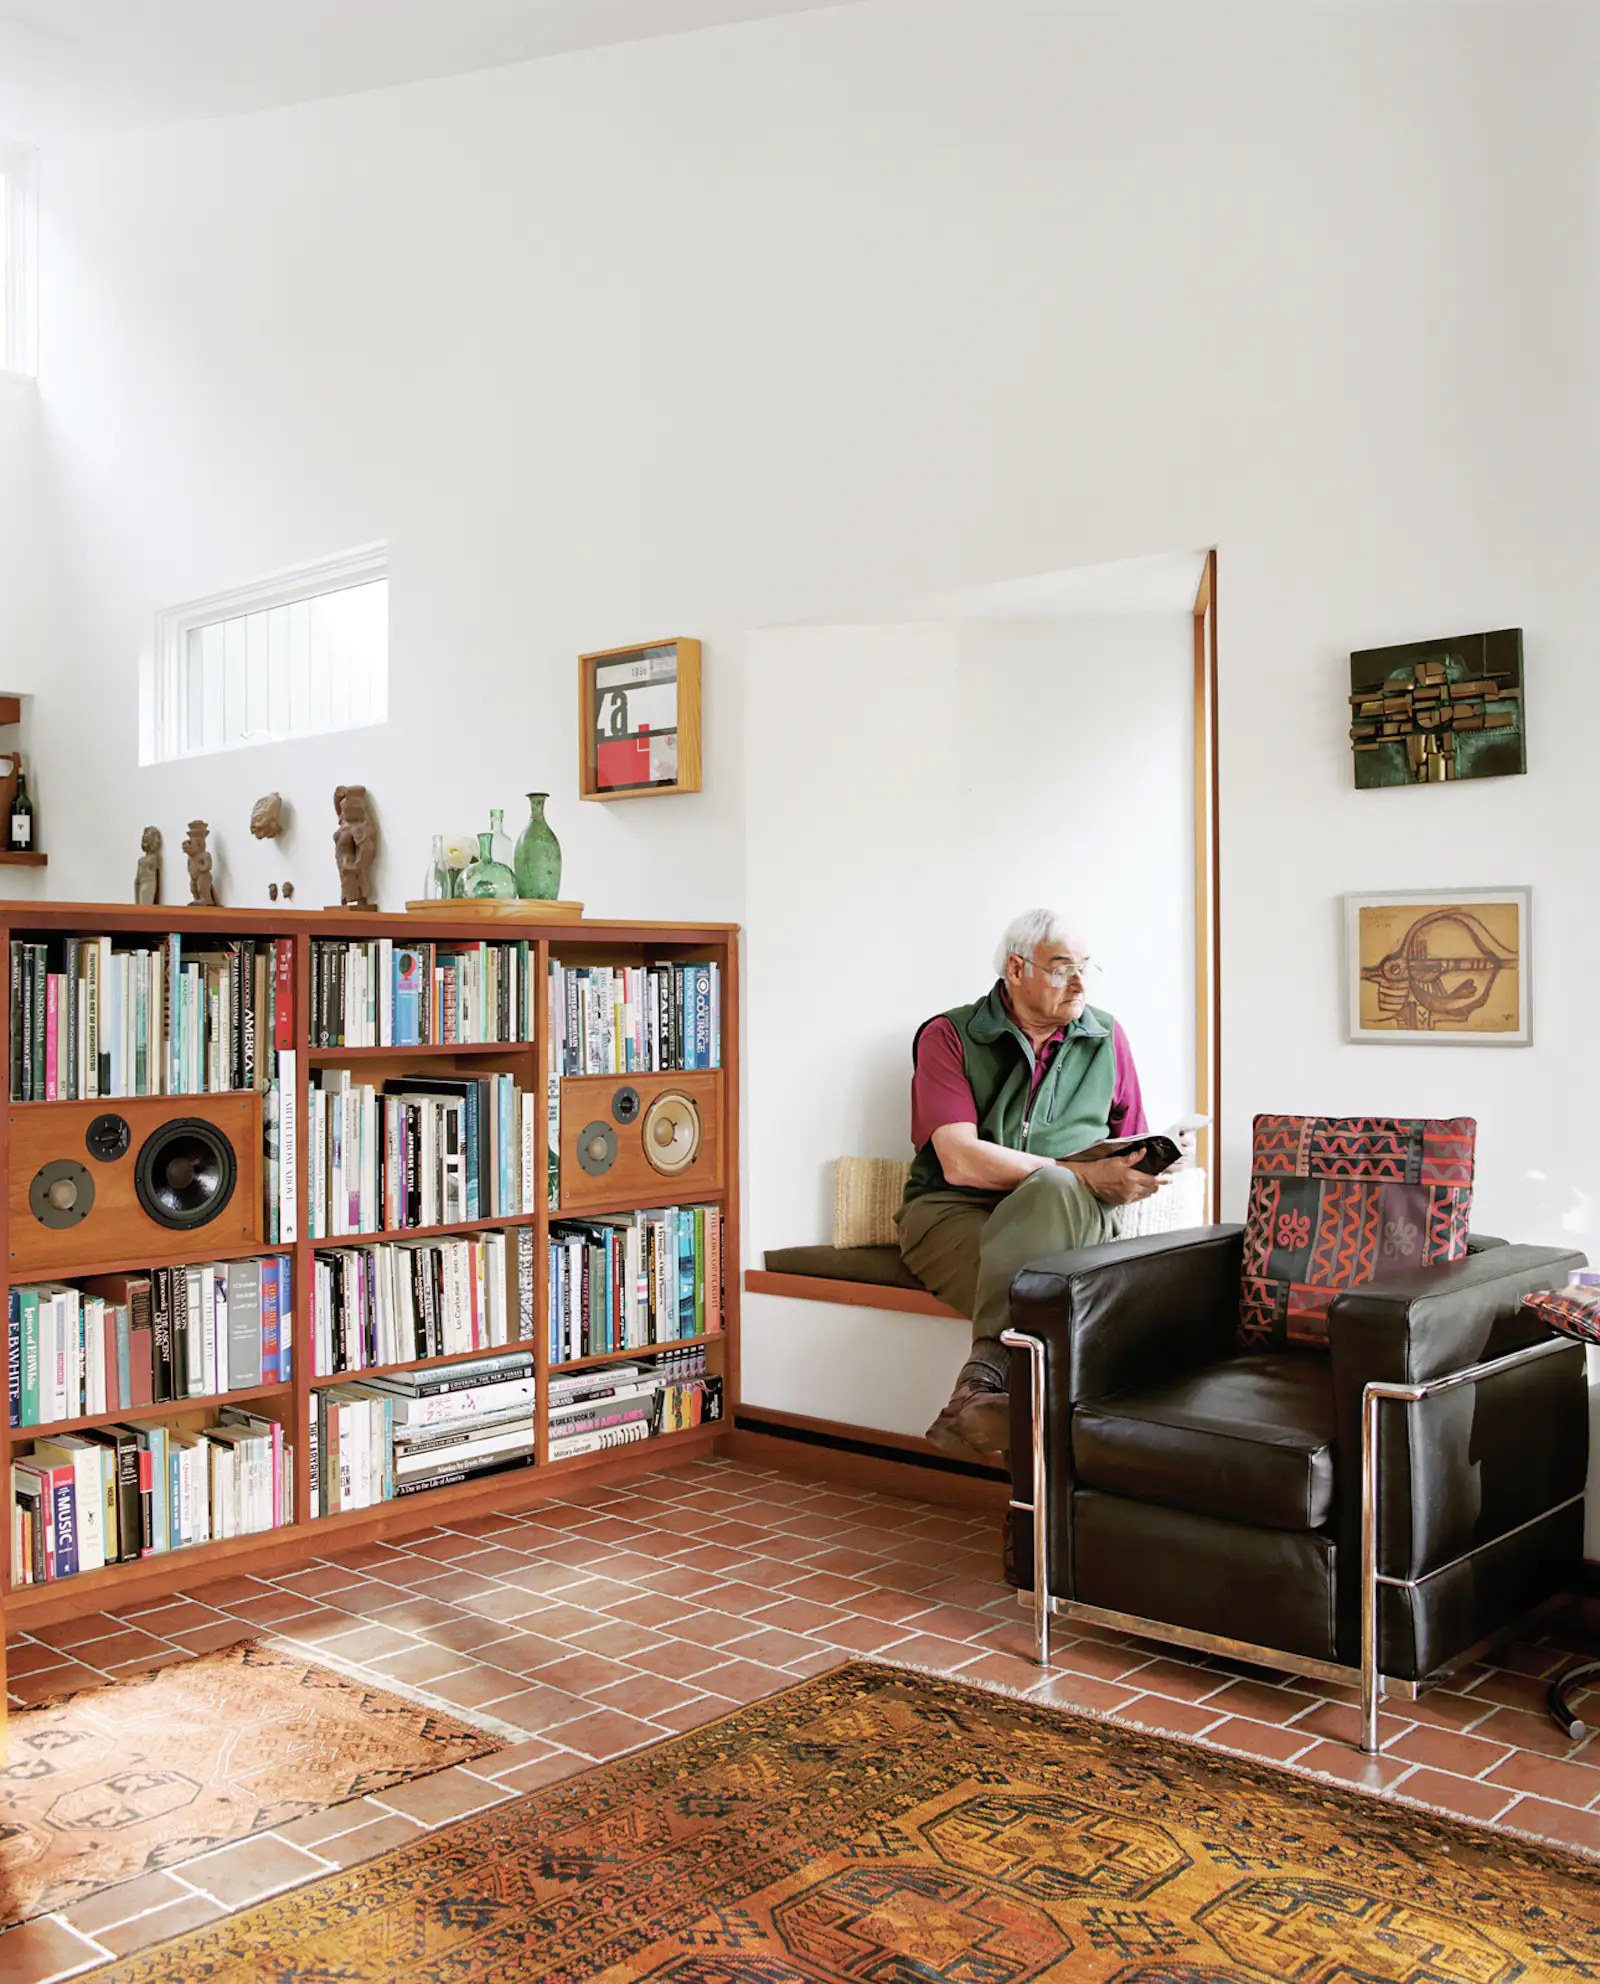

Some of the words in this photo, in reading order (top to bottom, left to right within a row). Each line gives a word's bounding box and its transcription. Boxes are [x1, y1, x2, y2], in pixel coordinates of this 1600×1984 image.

[37, 979, 44, 988] IN
[697, 996, 705, 1053] COURAGE
[245, 1009, 254, 1070] AMERICA
[285, 1134, 293, 1165] FROM
[711, 1259, 718, 1269] OF
[425, 1286, 431, 1300] ON
[25, 1307, 35, 1335] Letters
[155, 1312, 161, 1324] OF
[27, 1336, 35, 1344] of
[450, 1378, 477, 1388] COVERING
[556, 1416, 573, 1426] GREAT
[573, 1413, 588, 1423] BOOK
[576, 1420, 594, 1432] WAR
[600, 1409, 644, 1427] AIRPLANES
[310, 1420, 318, 1436] THE
[554, 1448, 572, 1458] Military
[573, 1444, 591, 1453] Aircraft
[310, 1441, 318, 1491] LABYRINTH
[445, 1475, 465, 1484] America
[58, 1496, 72, 1545] MUSIC
